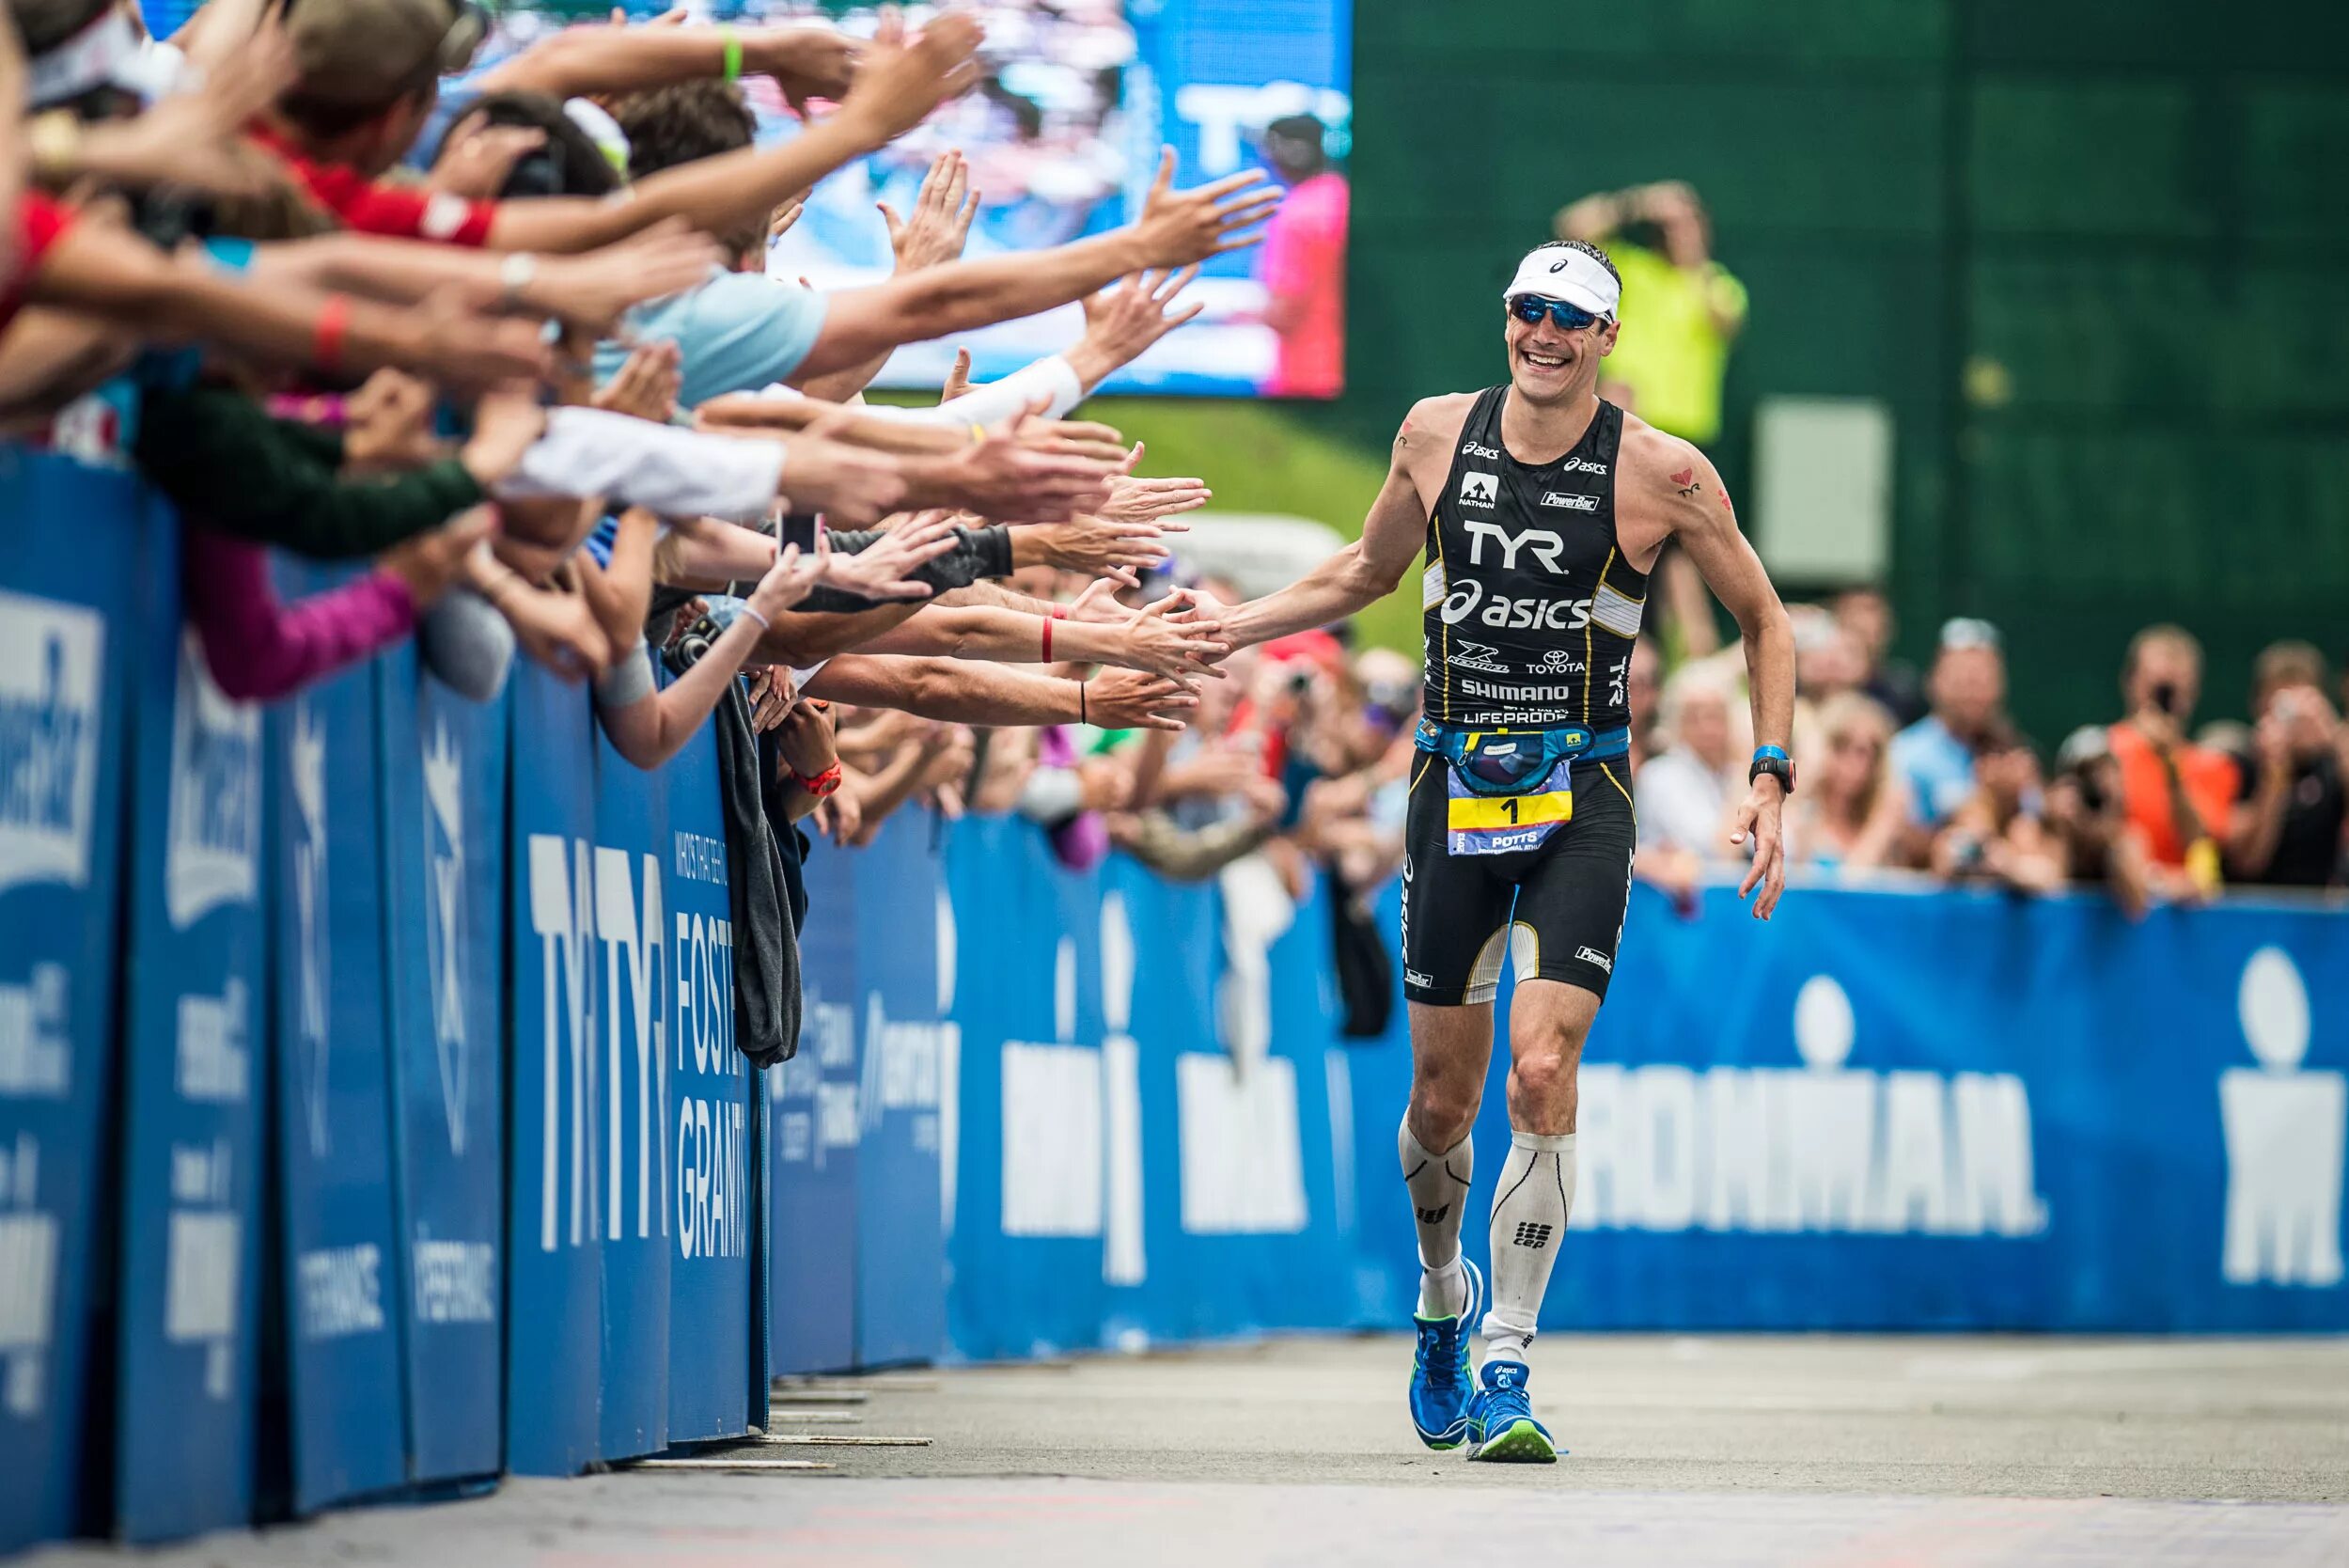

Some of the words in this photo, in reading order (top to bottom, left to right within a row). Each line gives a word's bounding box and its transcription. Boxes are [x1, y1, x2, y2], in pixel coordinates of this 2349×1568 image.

[1578, 461, 1606, 475] asics
[1458, 498, 1496, 510] NATHAN
[1545, 492, 1595, 510] PowerBar
[1464, 520, 1564, 574] TYR
[1481, 598, 1592, 630] asics
[1526, 662, 1586, 674] TOYOTA
[1462, 679, 1569, 701] SHIMANO
[1609, 655, 1626, 707] TYR
[1500, 798, 1518, 824] 1
[1457, 832, 1465, 853] 2013
[1492, 831, 1538, 848] POTTS
[676, 912, 744, 1077] FOSTE
[1572, 1064, 2036, 1236] RONMAN
